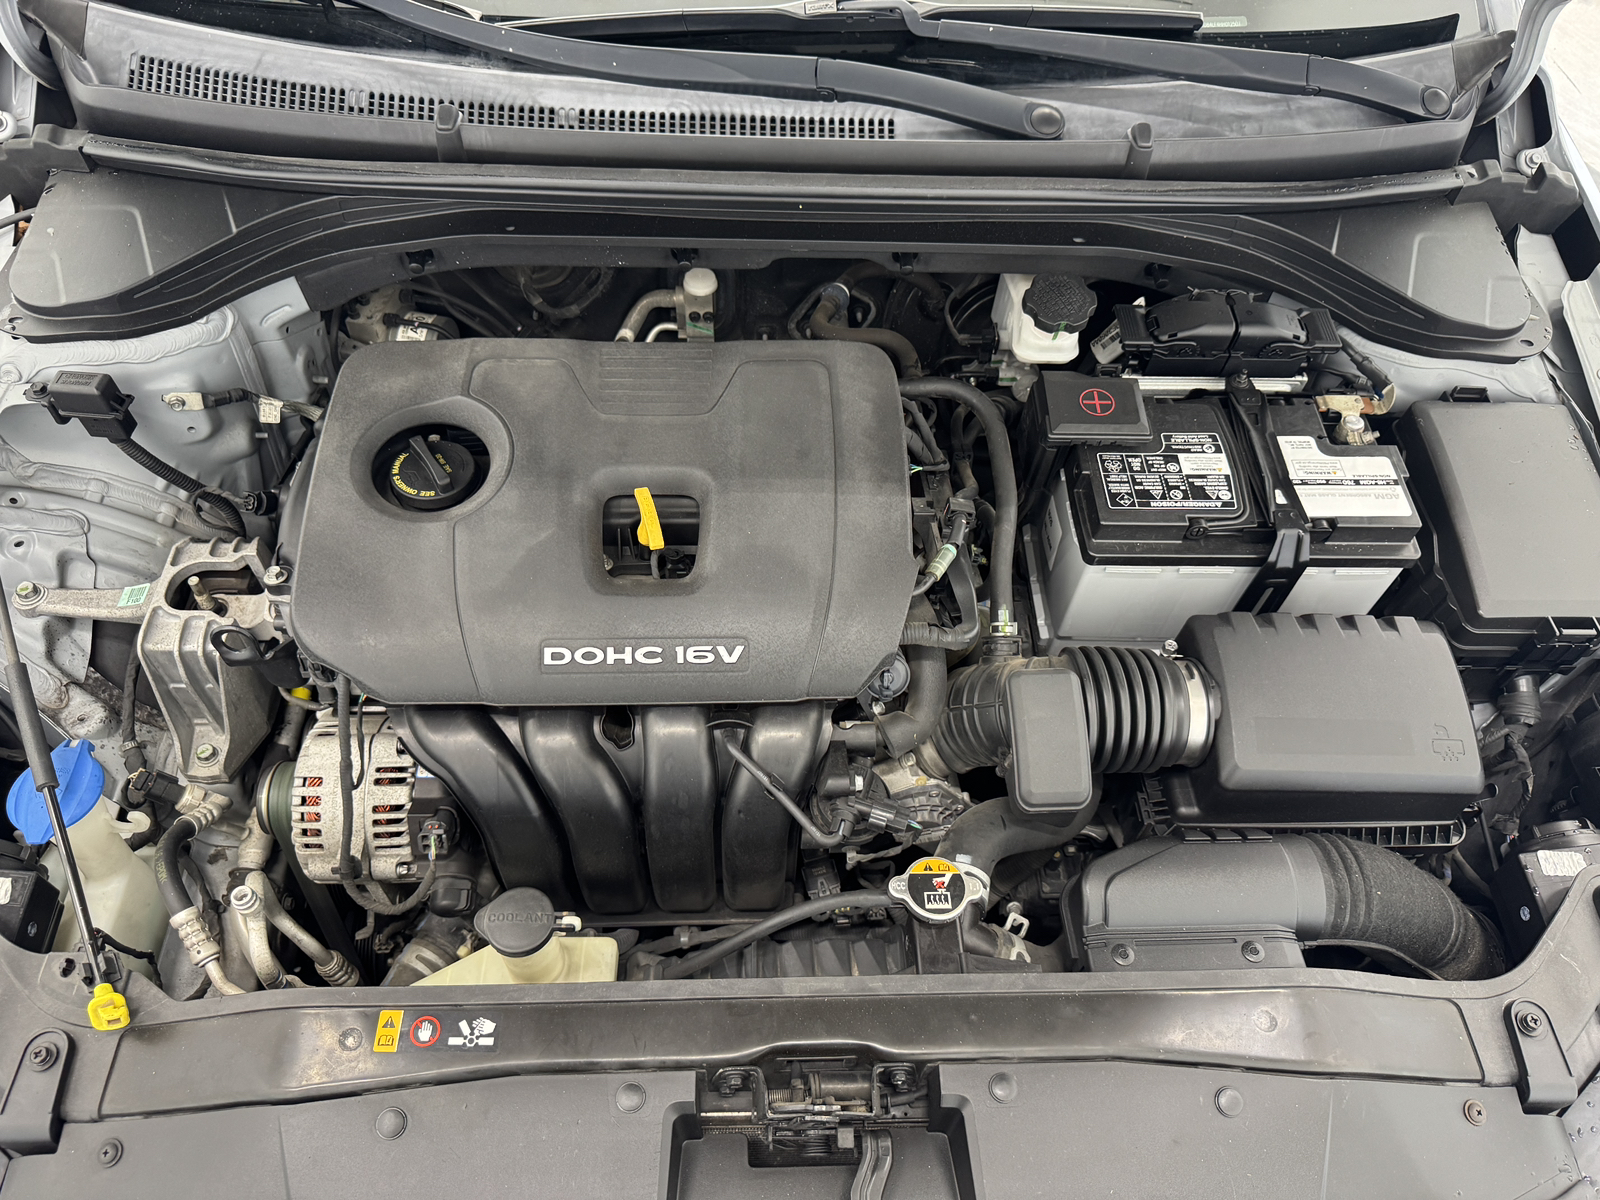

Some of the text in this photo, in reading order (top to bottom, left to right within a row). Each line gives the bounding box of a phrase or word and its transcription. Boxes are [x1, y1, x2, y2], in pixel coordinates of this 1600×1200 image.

[392, 453, 409, 474] MANUAL
[544, 646, 745, 665] DOHC 16V
[488, 912, 552, 924] COOLANT
